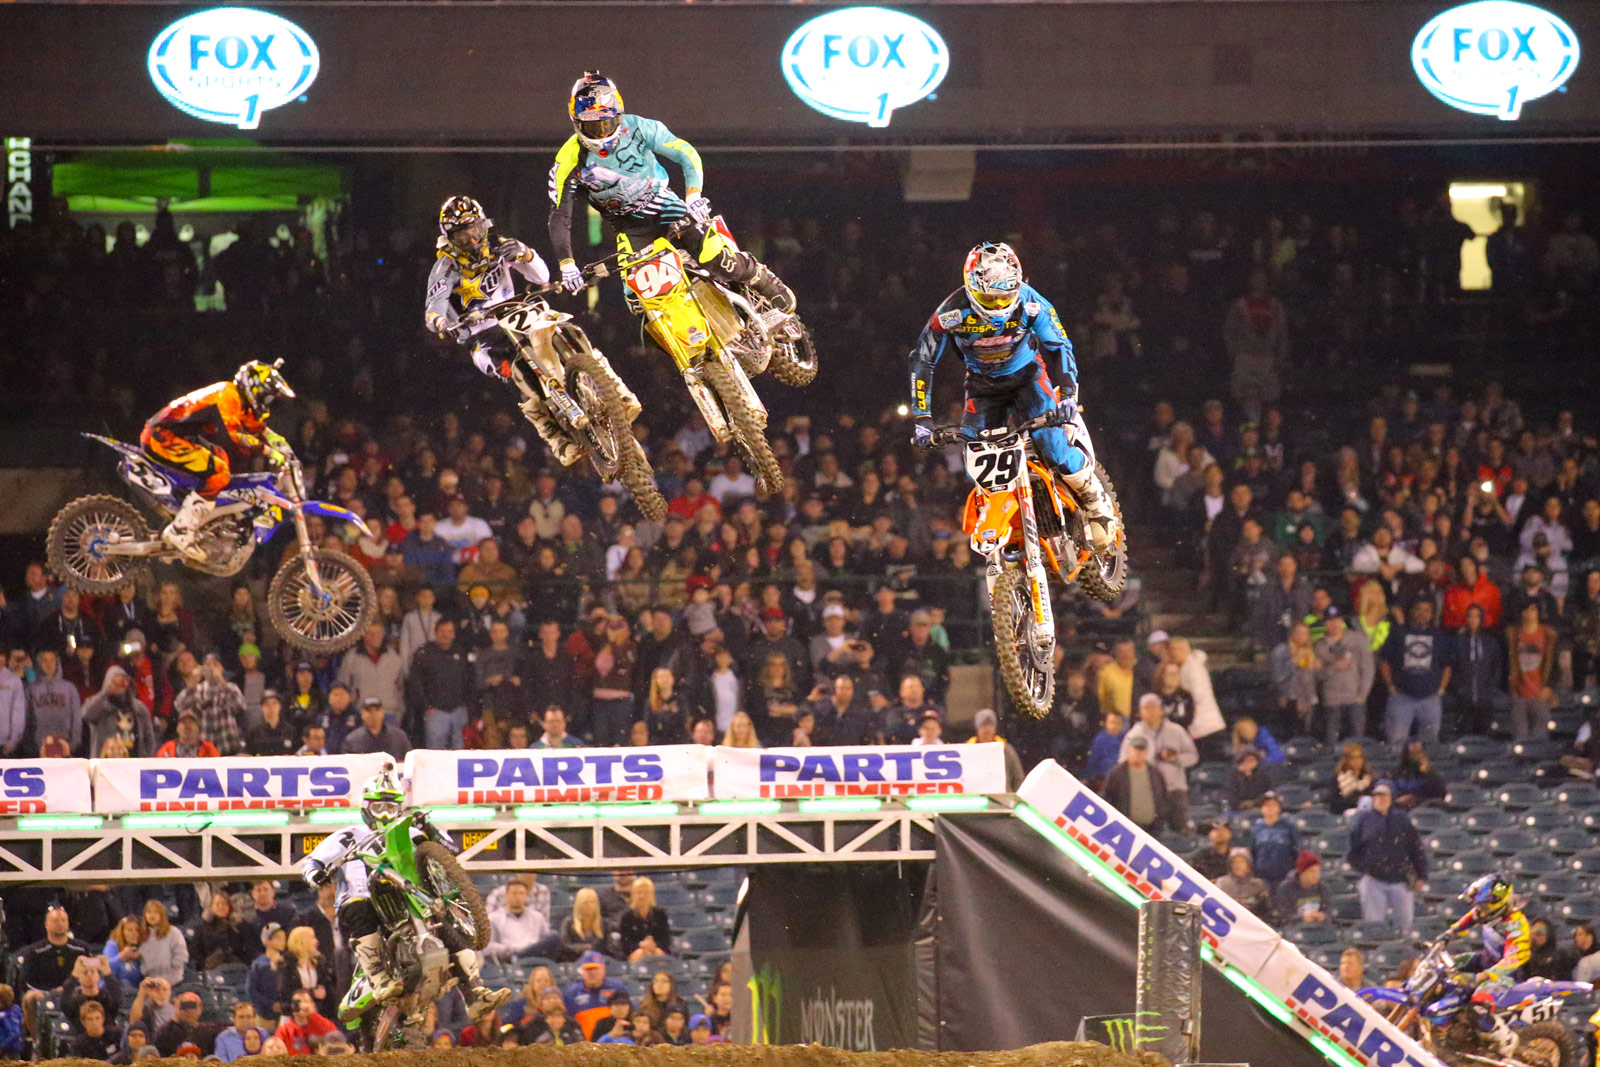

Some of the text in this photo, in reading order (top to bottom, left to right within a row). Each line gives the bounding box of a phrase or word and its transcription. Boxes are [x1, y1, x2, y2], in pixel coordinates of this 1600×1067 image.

[189, 34, 277, 70] FOX
[823, 34, 906, 69] FOX
[1453, 26, 1537, 62] FOX
[244, 94, 259, 122] 1
[876, 92, 889, 120] 1
[1506, 85, 1519, 113] 1
[635, 252, 681, 299] 94
[975, 449, 1022, 488] 29
[140, 767, 350, 798] PARTS
[458, 754, 663, 787] PARTS
[760, 751, 962, 781] PARTS
[458, 785, 663, 804] UNLIMITED
[1063, 791, 1237, 937] PARTS
[800, 986, 876, 1052] MONSTER
